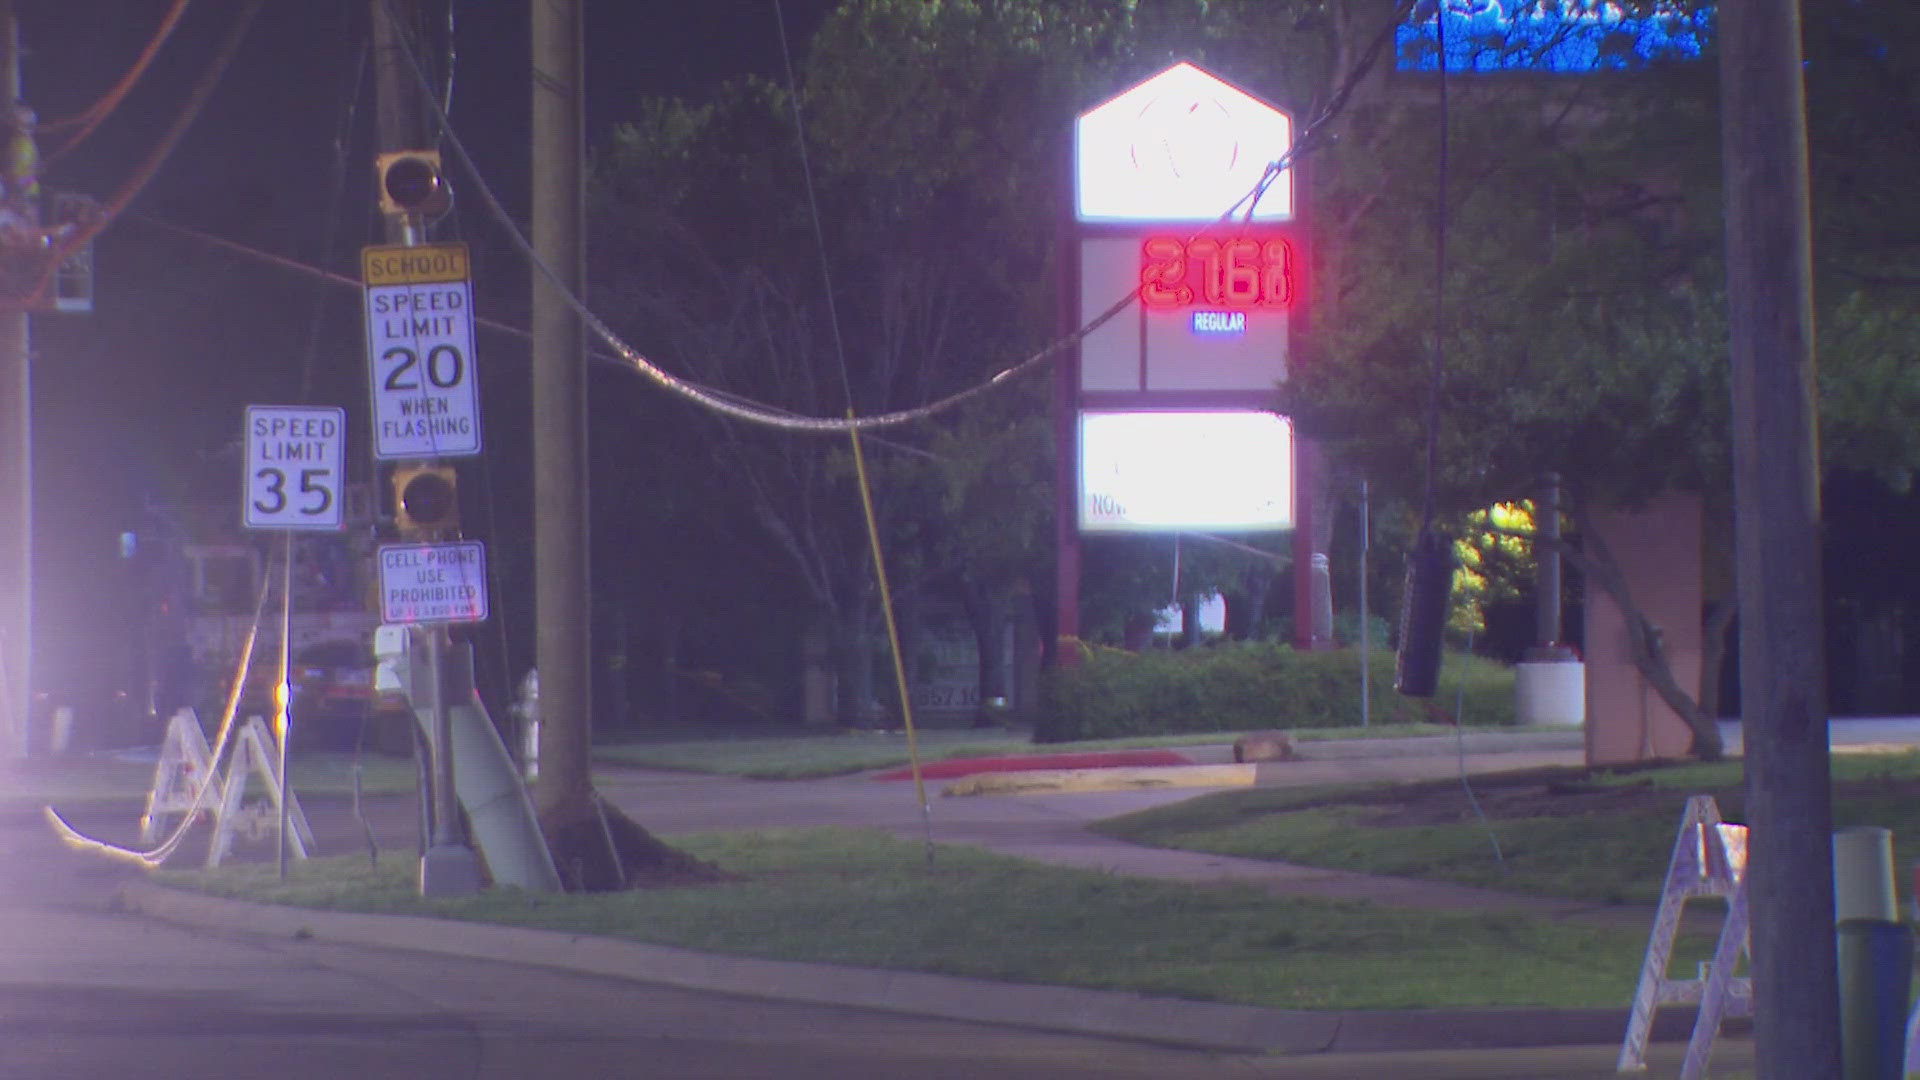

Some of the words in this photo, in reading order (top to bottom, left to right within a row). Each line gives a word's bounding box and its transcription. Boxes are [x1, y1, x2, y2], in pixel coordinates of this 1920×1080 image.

[371, 254, 458, 278] SCHOOL
[375, 290, 463, 314] SPEED
[385, 316, 455, 339] LIMIT
[1193, 311, 1246, 333] REGULAR
[382, 343, 465, 391] 20
[400, 396, 448, 417] WHEN
[254, 417, 336, 439] SPEED
[383, 416, 470, 438] FLASHING
[262, 441, 326, 461] LIMIT
[254, 466, 333, 515] 35
[386, 553, 421, 569] CELL
[427, 549, 476, 565] PHONE
[416, 569, 445, 584] USE
[391, 585, 476, 602] PROHIBITED
